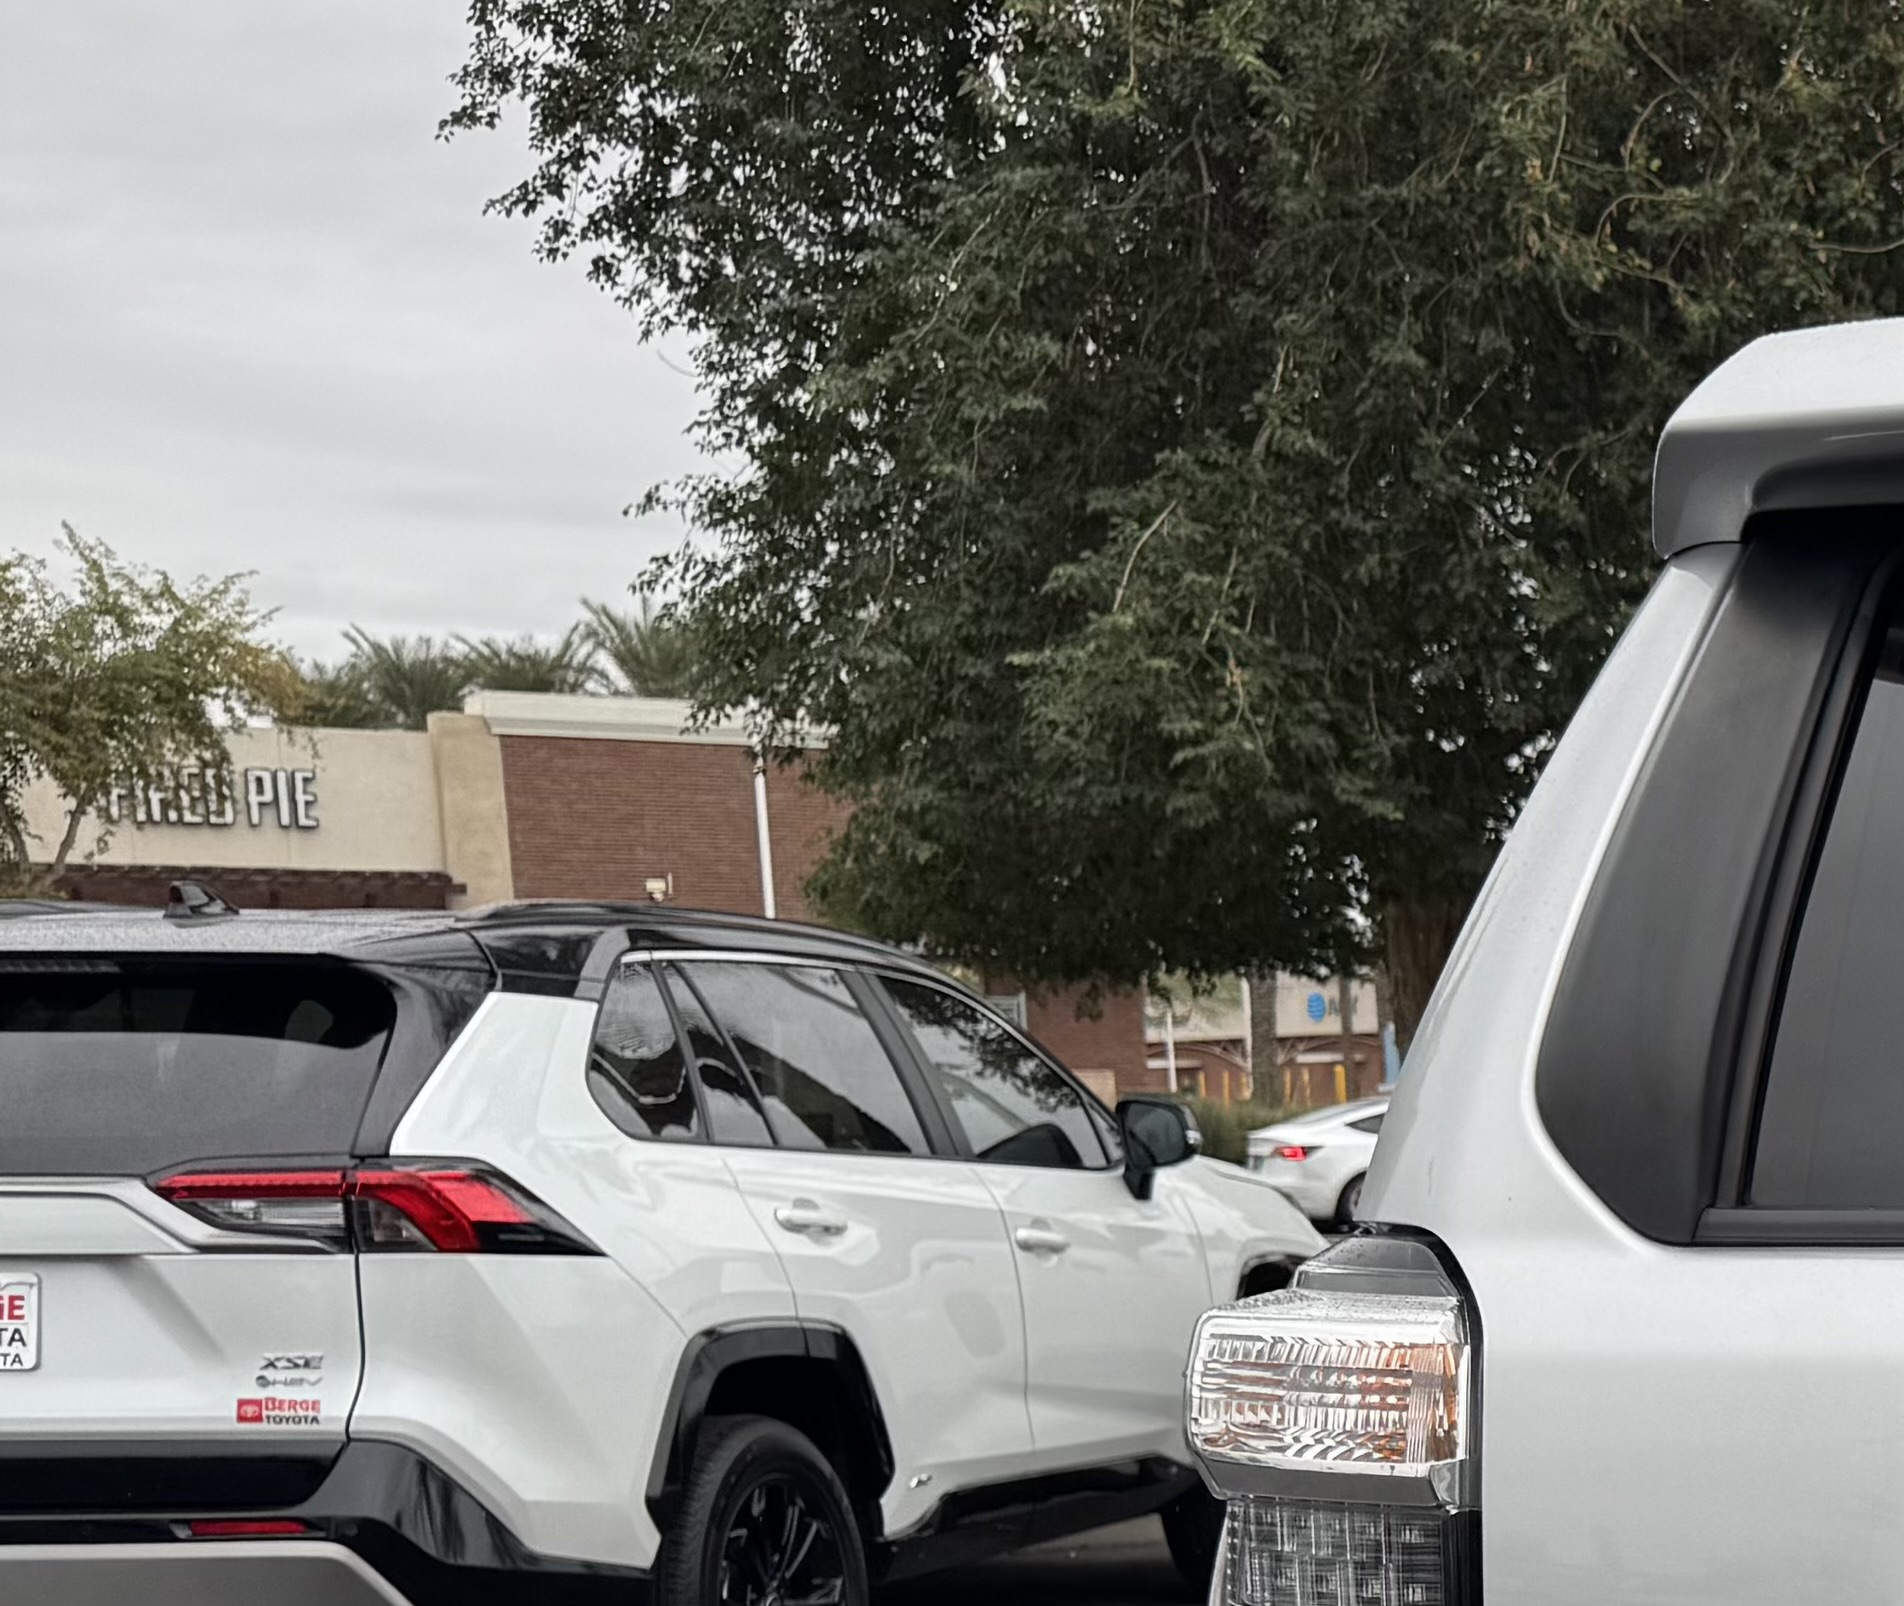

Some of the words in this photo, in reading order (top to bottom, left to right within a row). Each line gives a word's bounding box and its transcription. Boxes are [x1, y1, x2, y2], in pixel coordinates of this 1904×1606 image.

[245, 769, 319, 828] PIE
[264, 1397, 321, 1413] BERGE
[265, 1415, 320, 1425] TOYOTA
